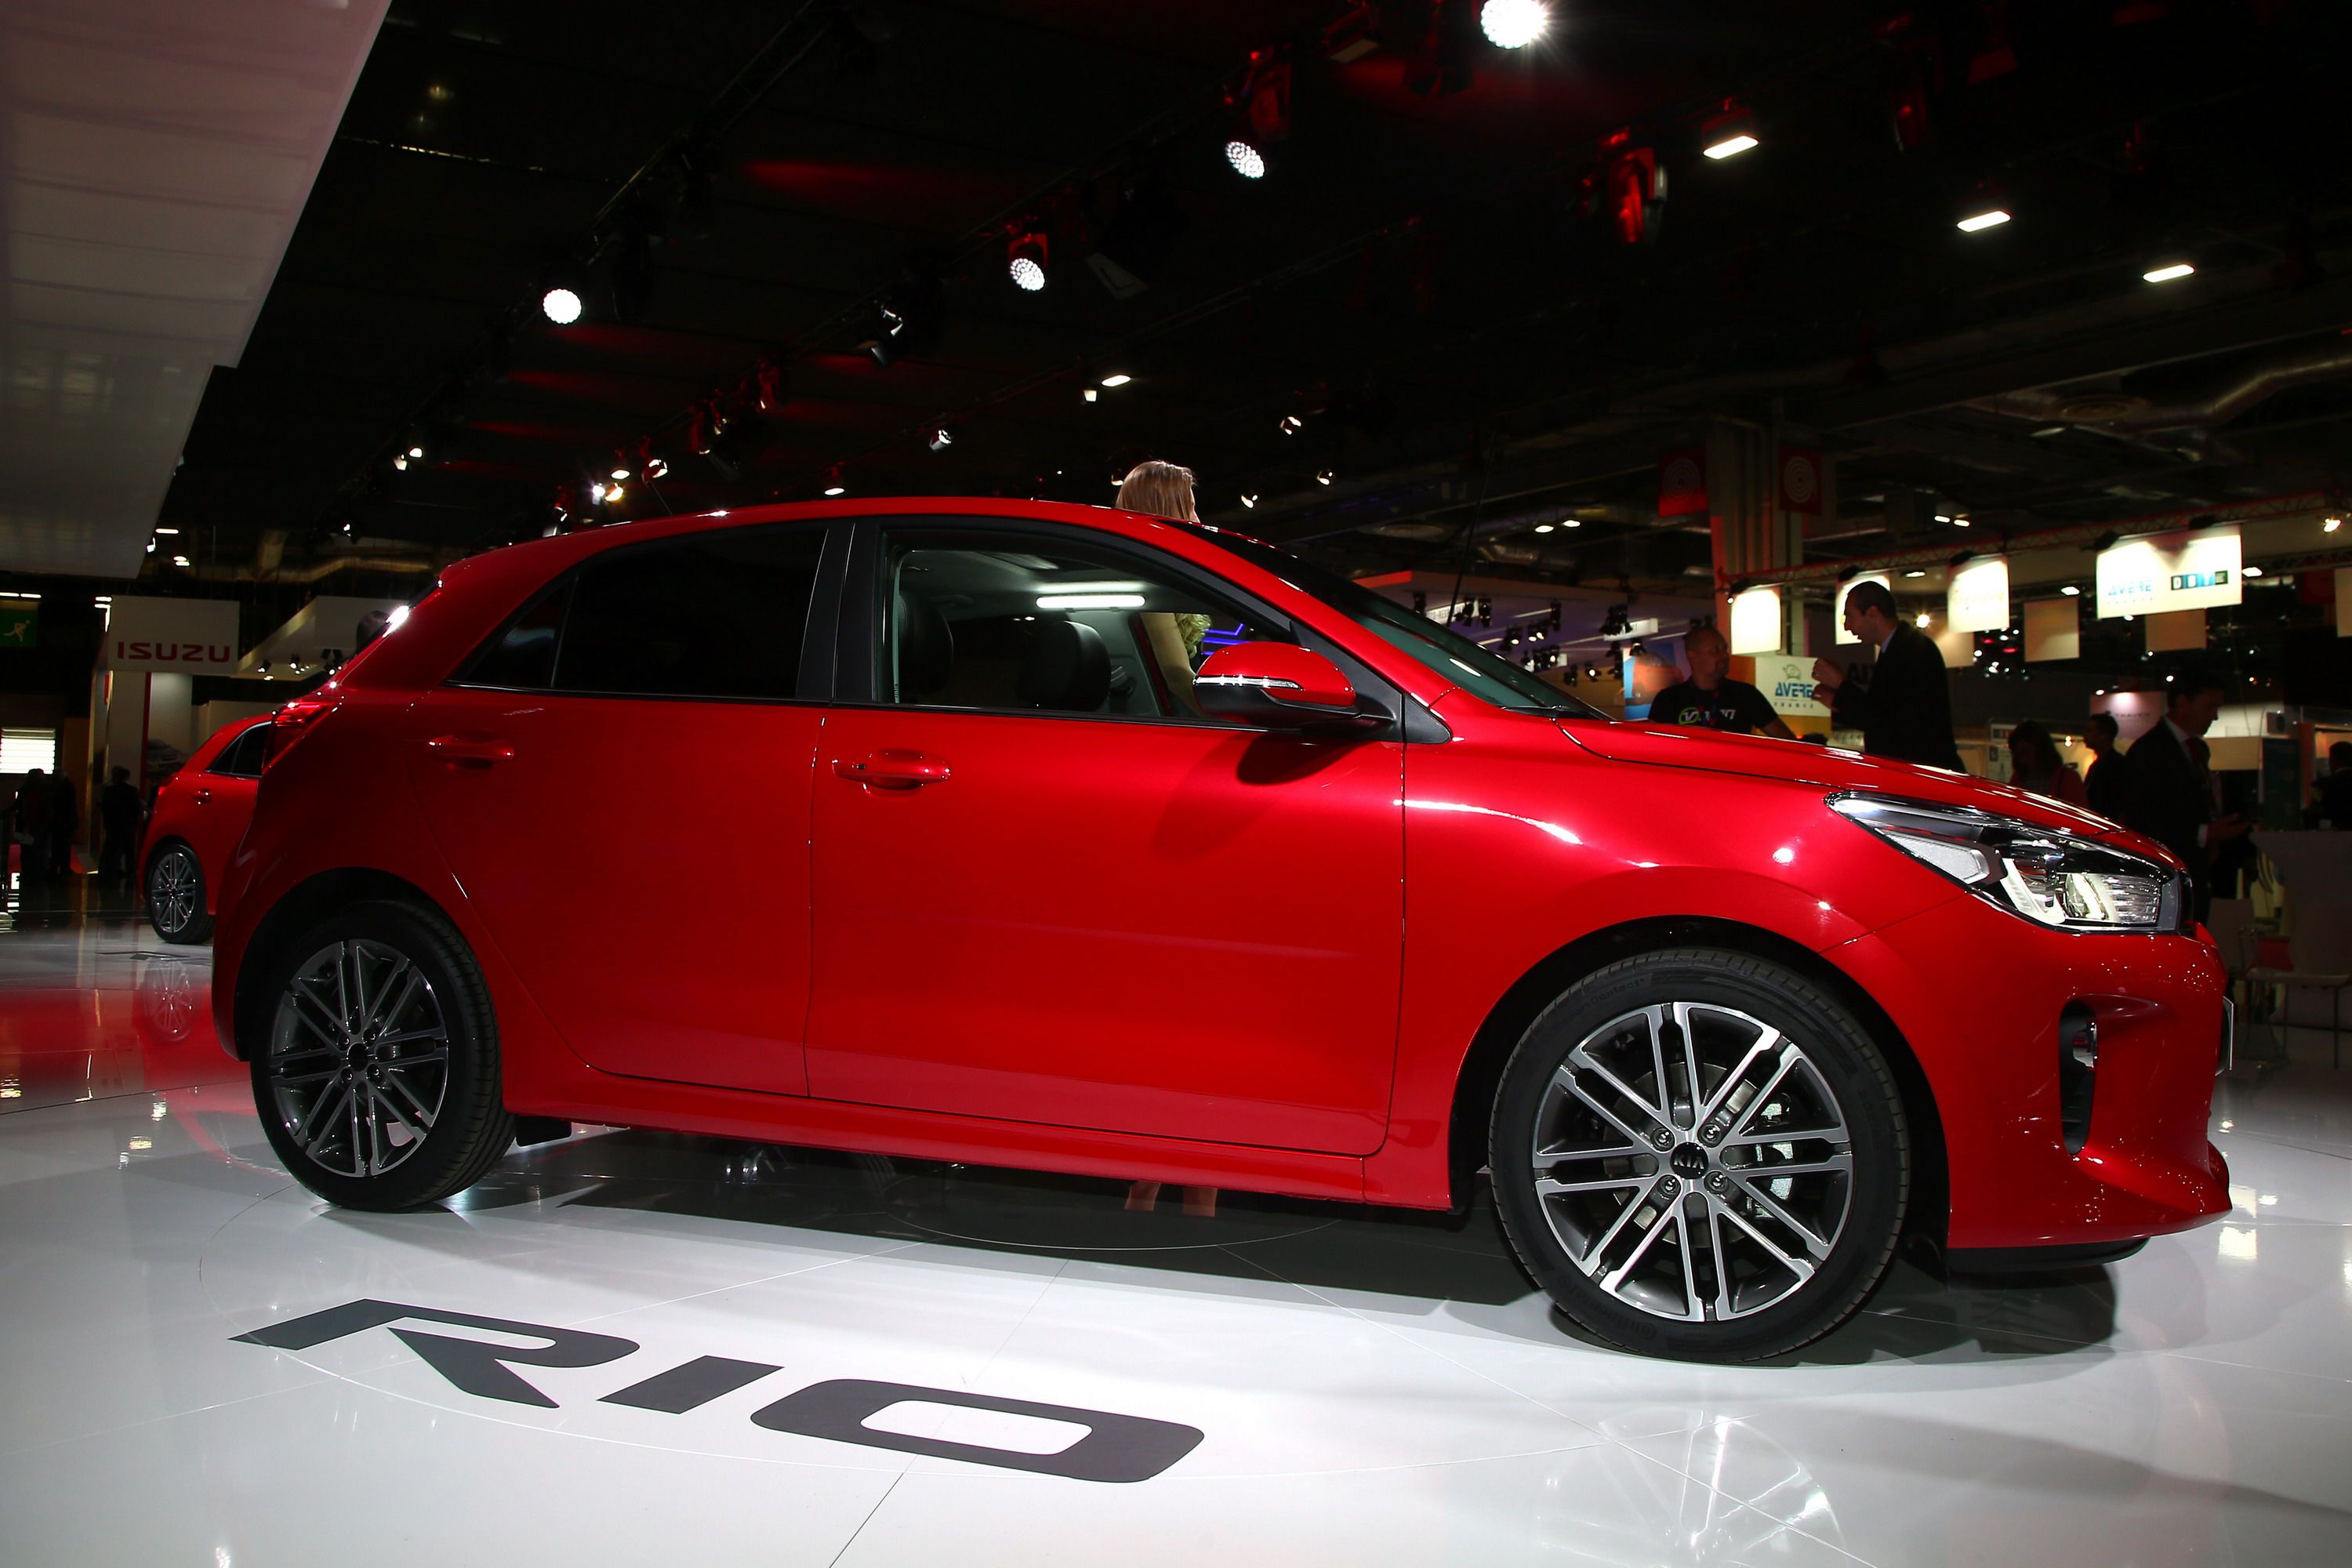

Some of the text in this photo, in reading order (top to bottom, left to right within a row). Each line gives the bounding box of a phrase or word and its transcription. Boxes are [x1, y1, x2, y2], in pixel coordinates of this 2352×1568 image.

[118, 641, 230, 662] ISUZU
[1673, 1153, 1705, 1171] KIA
[227, 1298, 1206, 1484] RIO
